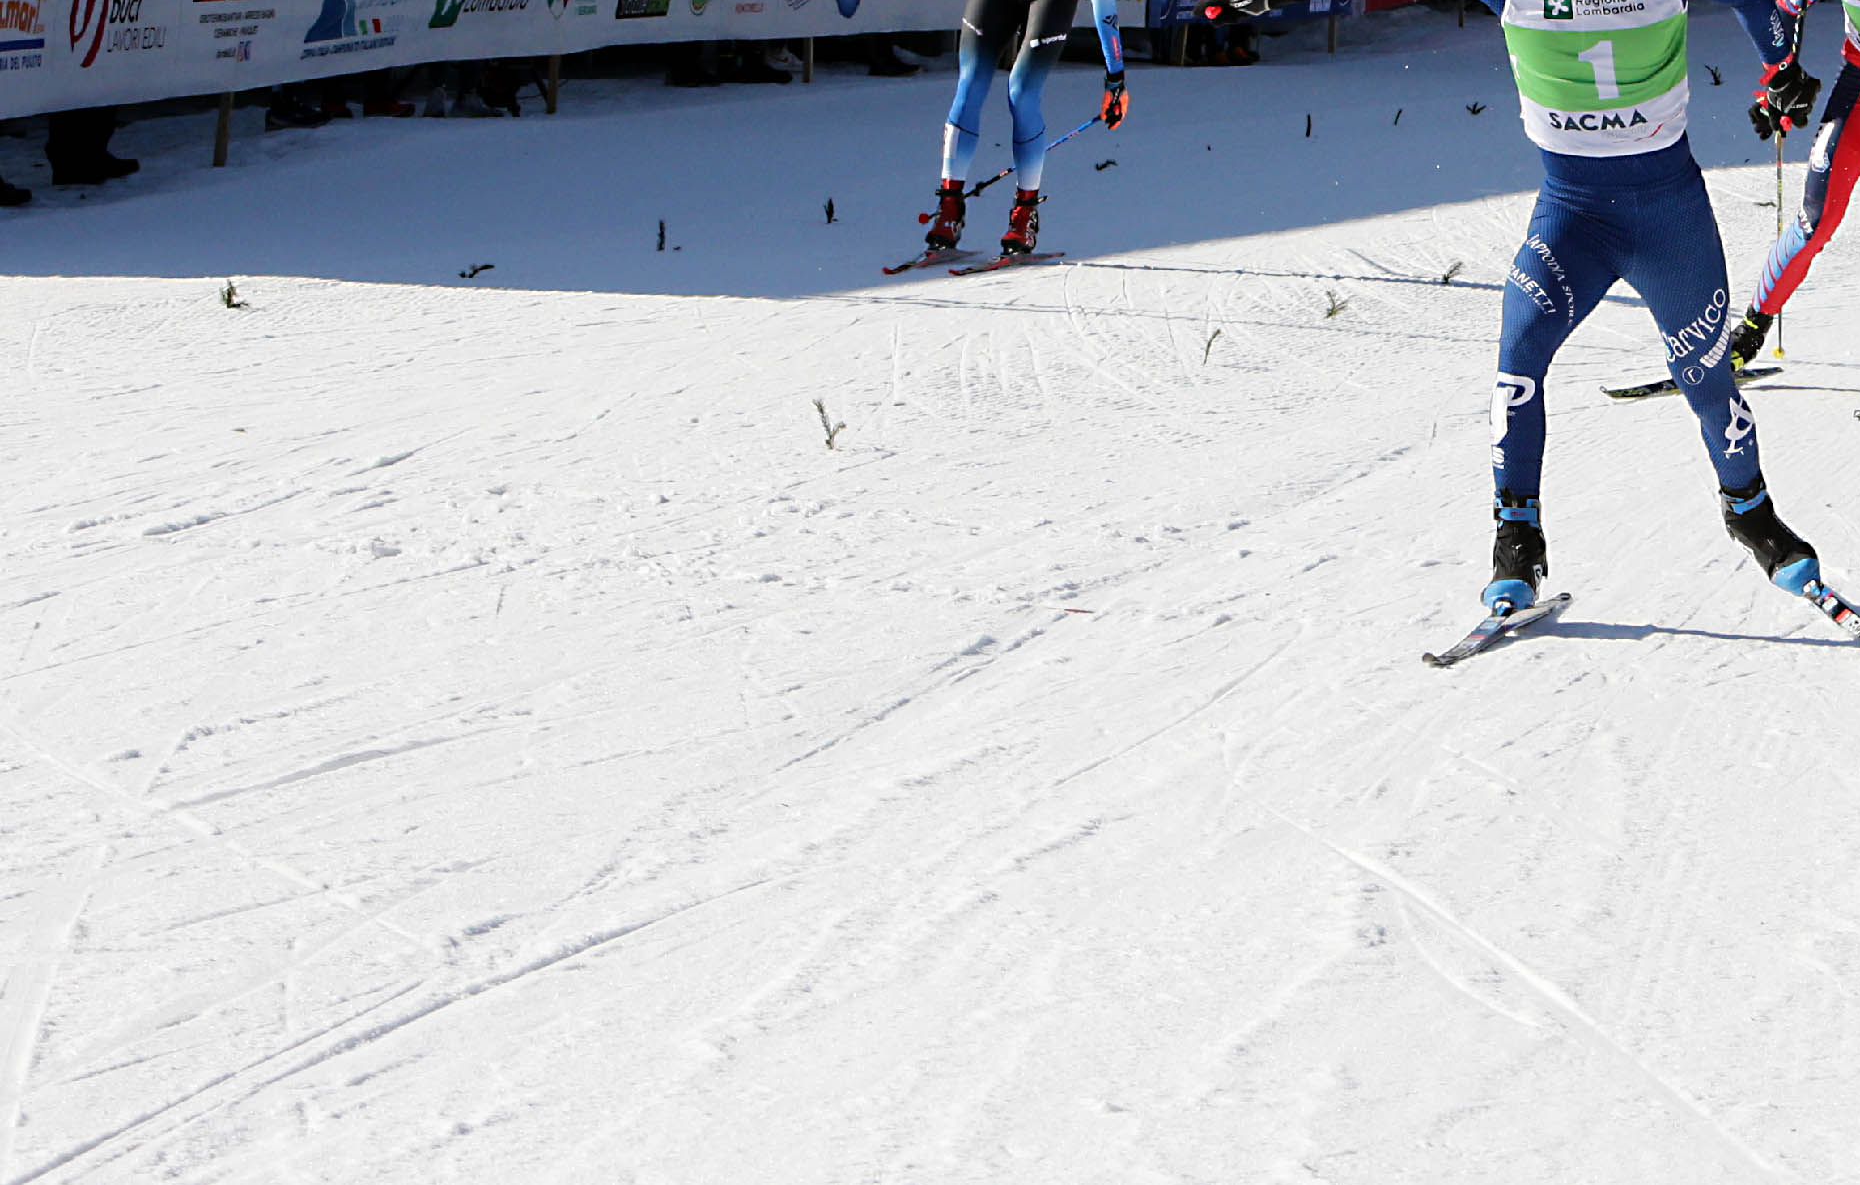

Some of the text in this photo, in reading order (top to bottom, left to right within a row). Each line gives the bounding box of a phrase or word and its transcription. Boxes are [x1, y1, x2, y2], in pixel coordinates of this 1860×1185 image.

[1576, 2, 1645, 16] Lombardia
[1578, 40, 1619, 100] 1
[1549, 109, 1648, 132] SACMA
